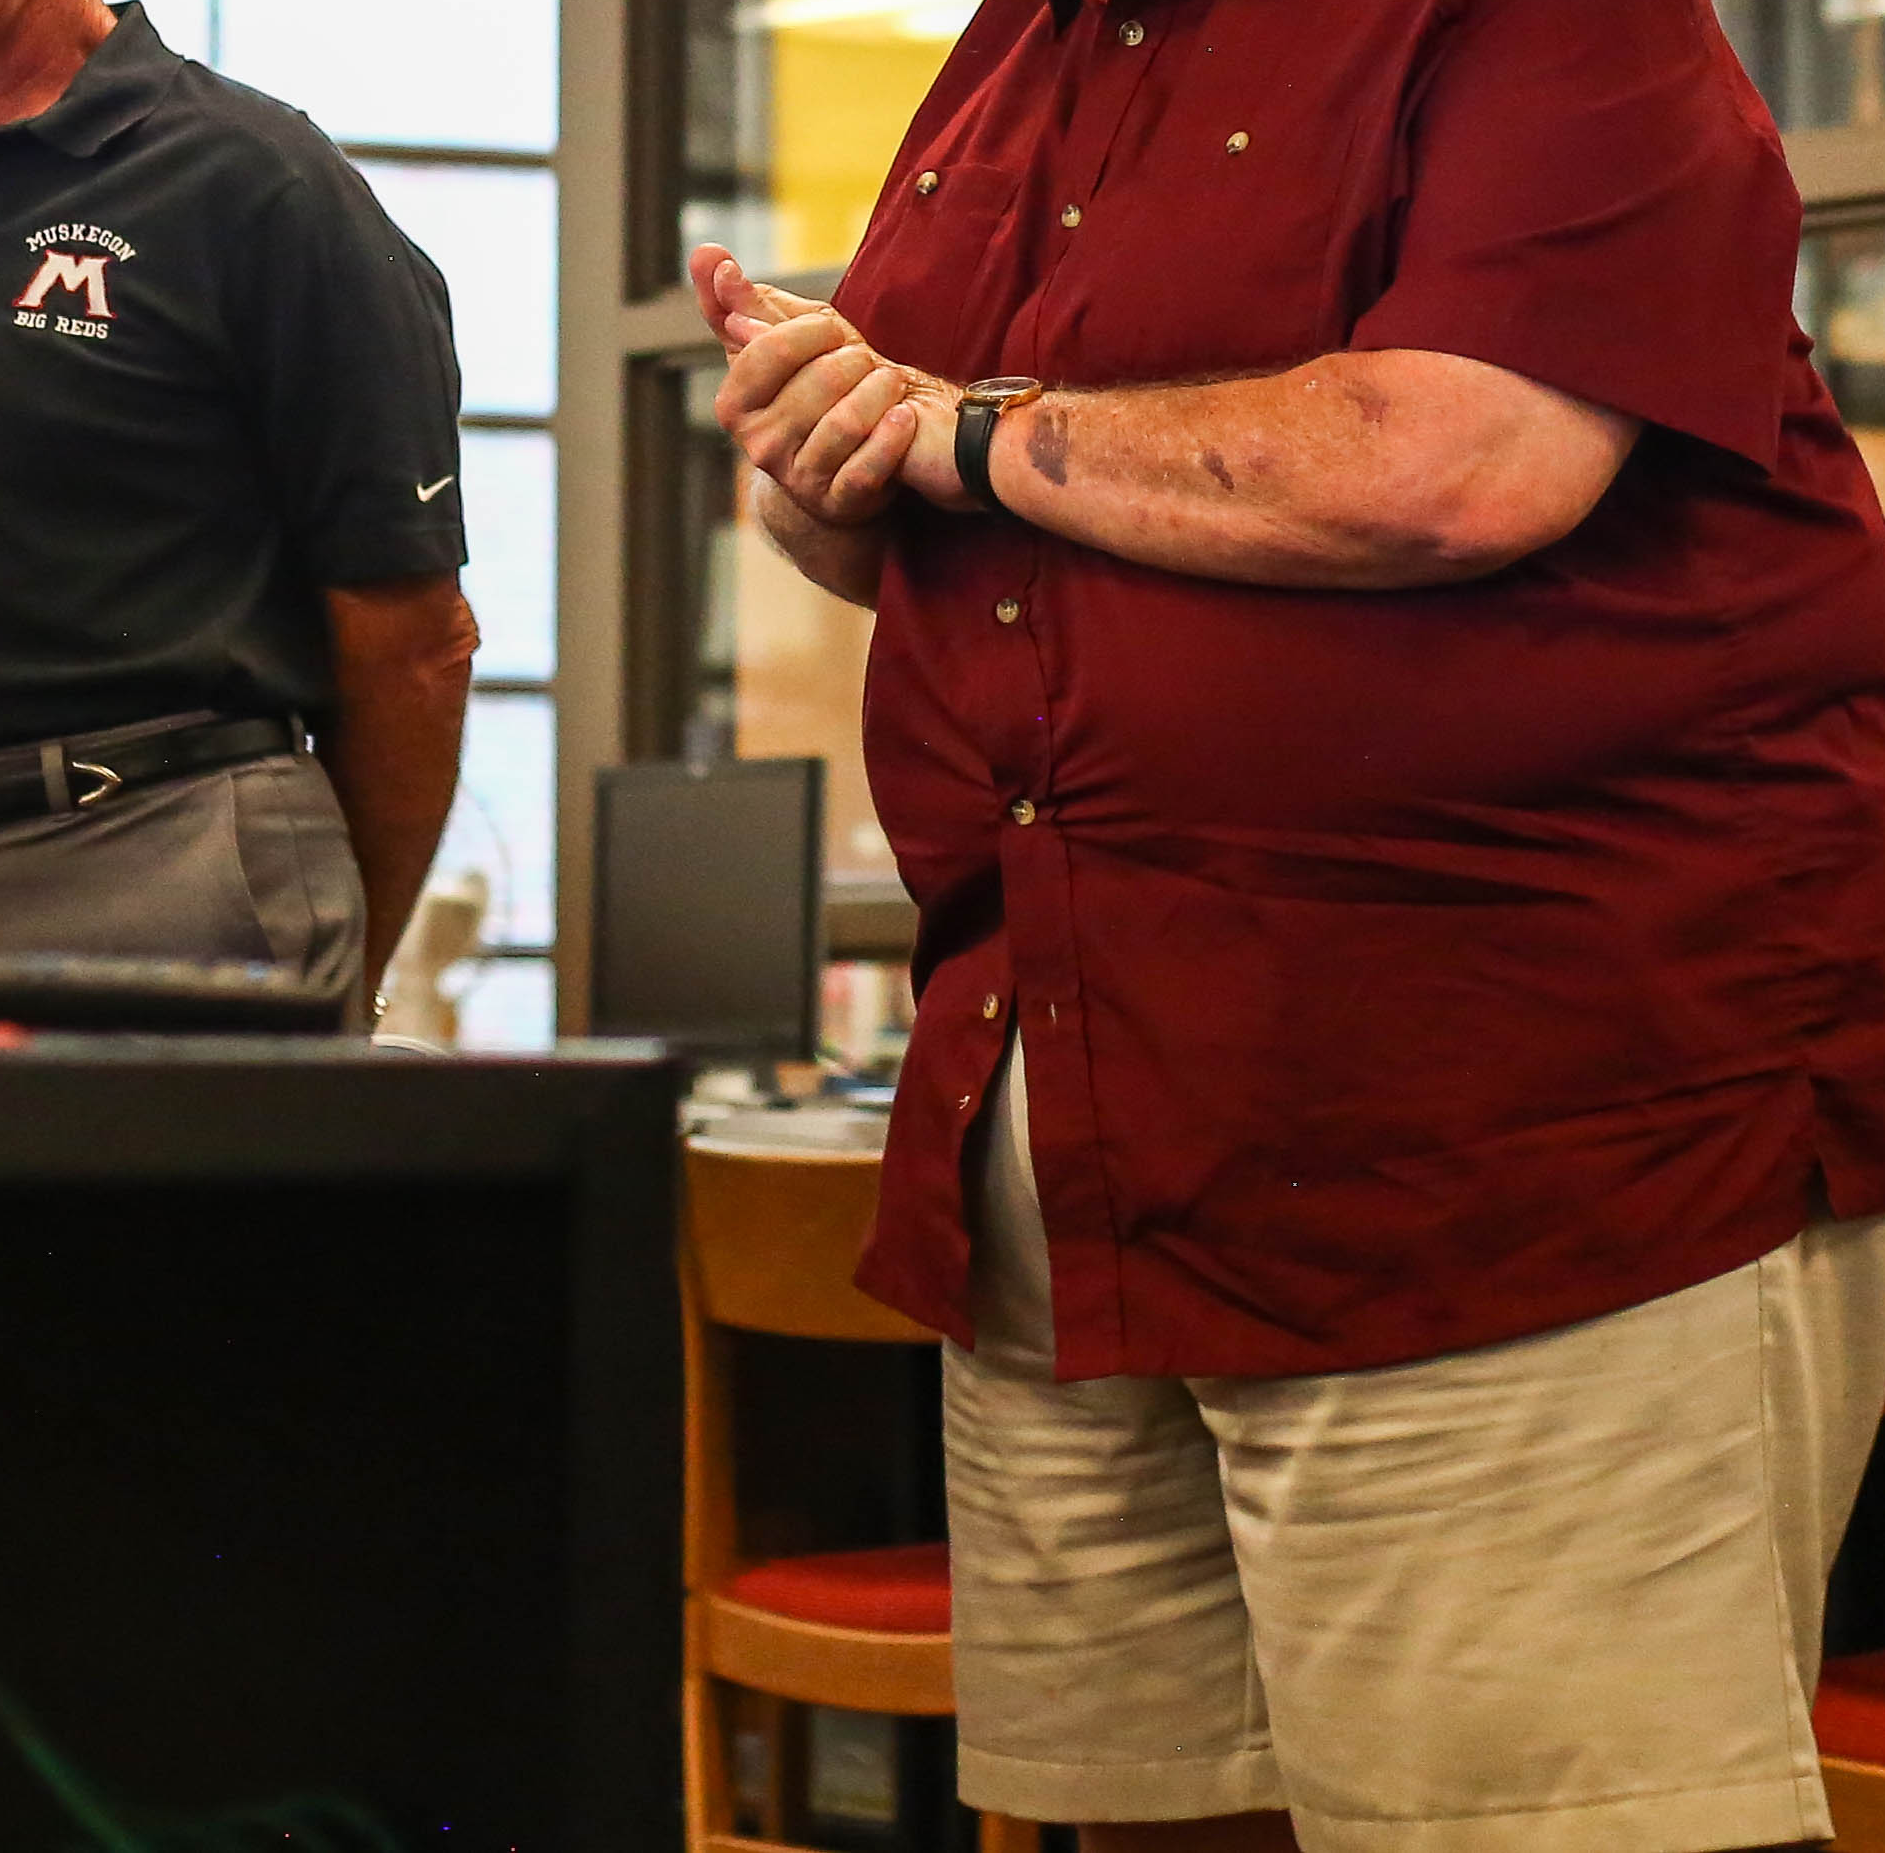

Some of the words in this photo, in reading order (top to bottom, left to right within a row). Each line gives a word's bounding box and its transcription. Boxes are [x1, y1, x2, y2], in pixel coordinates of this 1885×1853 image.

[25, 223, 137, 263] MUSKEGON
[12, 248, 117, 319] M
[13, 310, 48, 330] BIG
[54, 314, 109, 340] REDS
